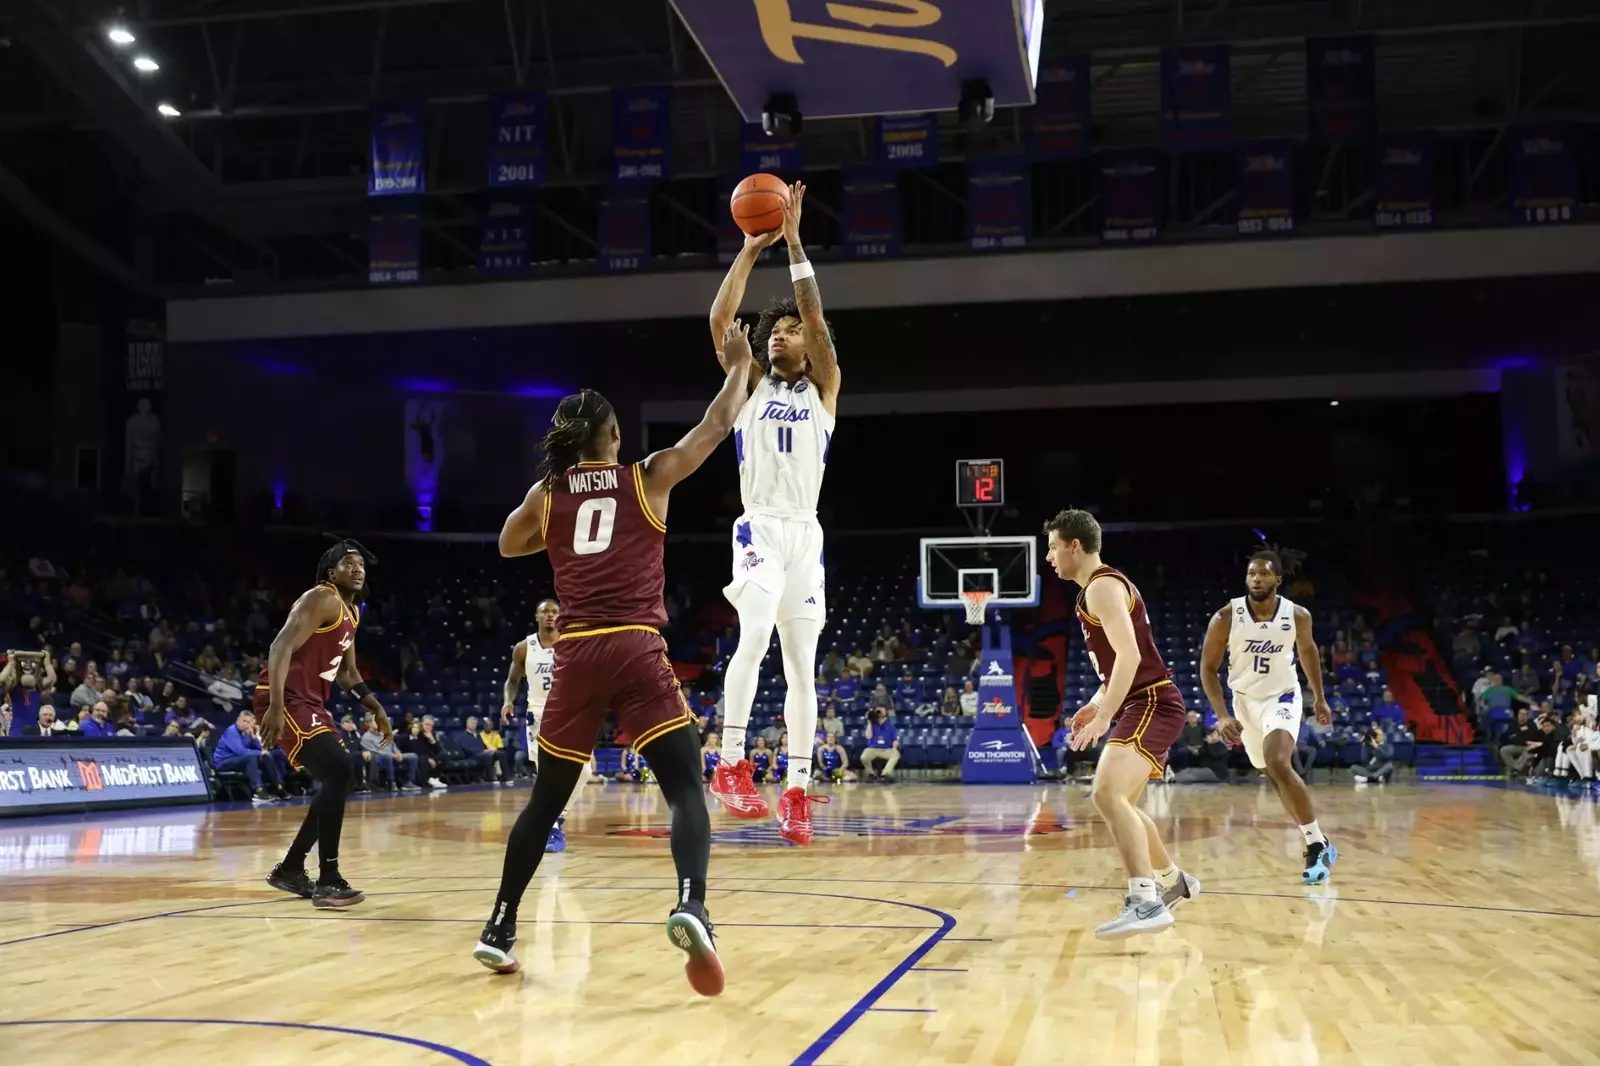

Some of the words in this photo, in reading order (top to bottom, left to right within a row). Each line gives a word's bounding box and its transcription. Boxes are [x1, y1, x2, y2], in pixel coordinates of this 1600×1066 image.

[498, 125, 537, 143] NIT
[498, 163, 535, 181] 2001
[759, 401, 810, 422] Tulsa
[778, 427, 792, 453] 11
[568, 469, 618, 494] WATSON
[976, 478, 994, 501] 12
[573, 497, 617, 555] 0
[1243, 640, 1284, 654] Tulsa
[1253, 655, 1270, 674] 15
[981, 703, 1013, 714] Tulsa
[968, 751, 985, 759] DON
[986, 751, 1026, 759] THORNTON
[0, 769, 26, 791] RST
[28, 766, 73, 790] BANK
[163, 763, 200, 784] BANK
